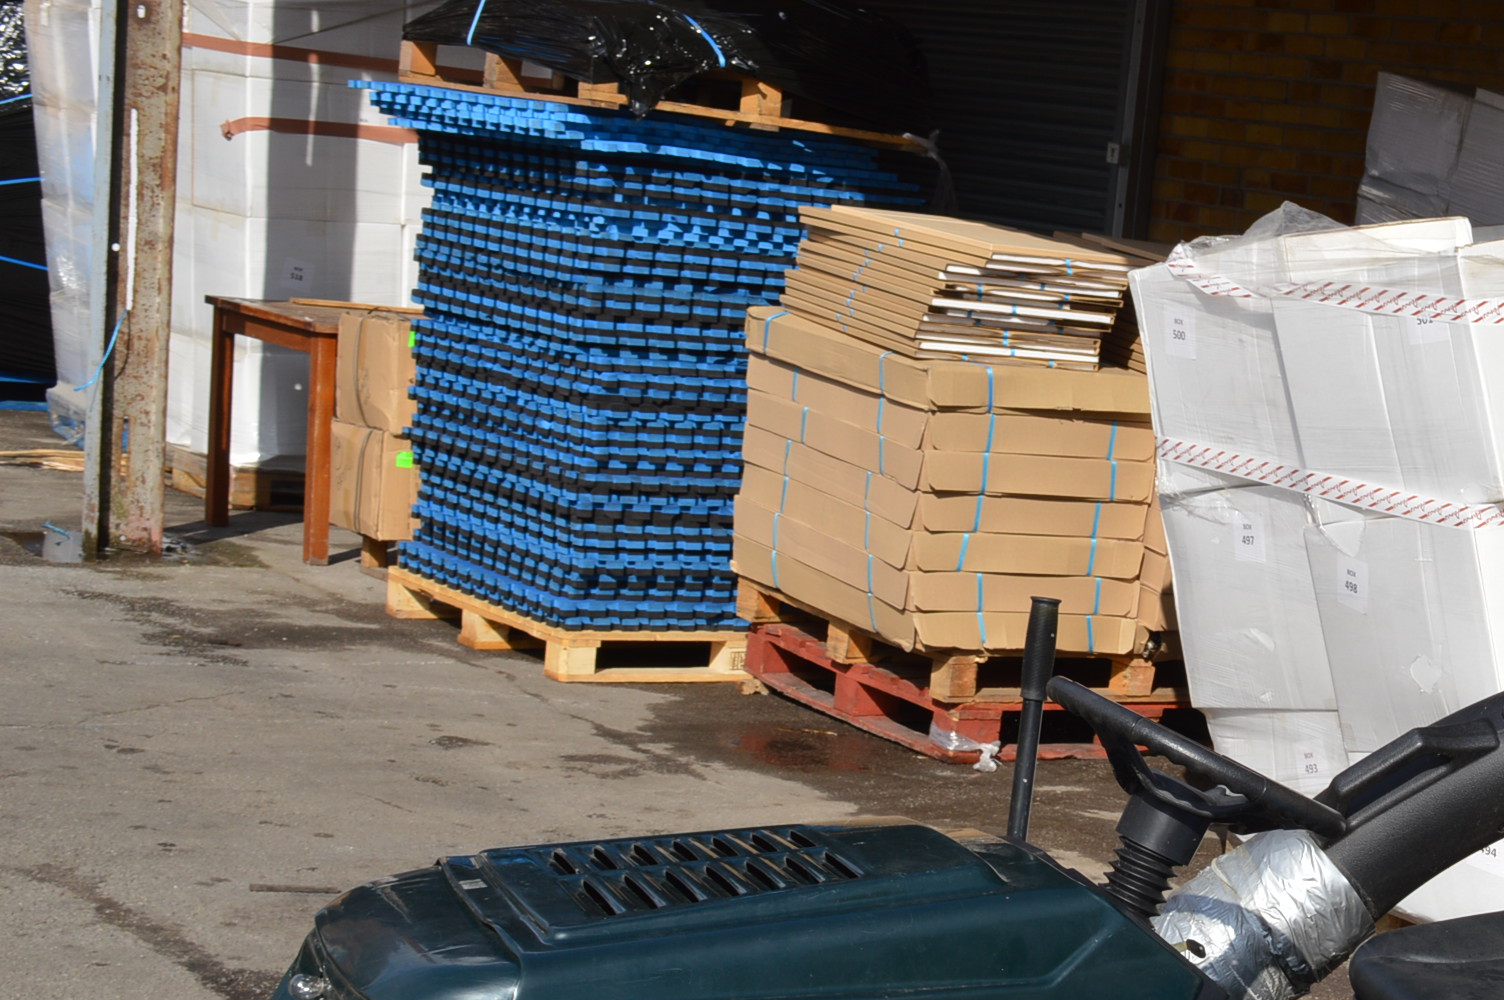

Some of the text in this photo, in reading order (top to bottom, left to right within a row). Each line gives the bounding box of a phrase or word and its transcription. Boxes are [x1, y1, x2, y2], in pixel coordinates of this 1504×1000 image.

[1172, 329, 1186, 341] 500
[1241, 535, 1255, 545] 497
[1344, 580, 1358, 594] 498
[1304, 763, 1318, 774] 493
